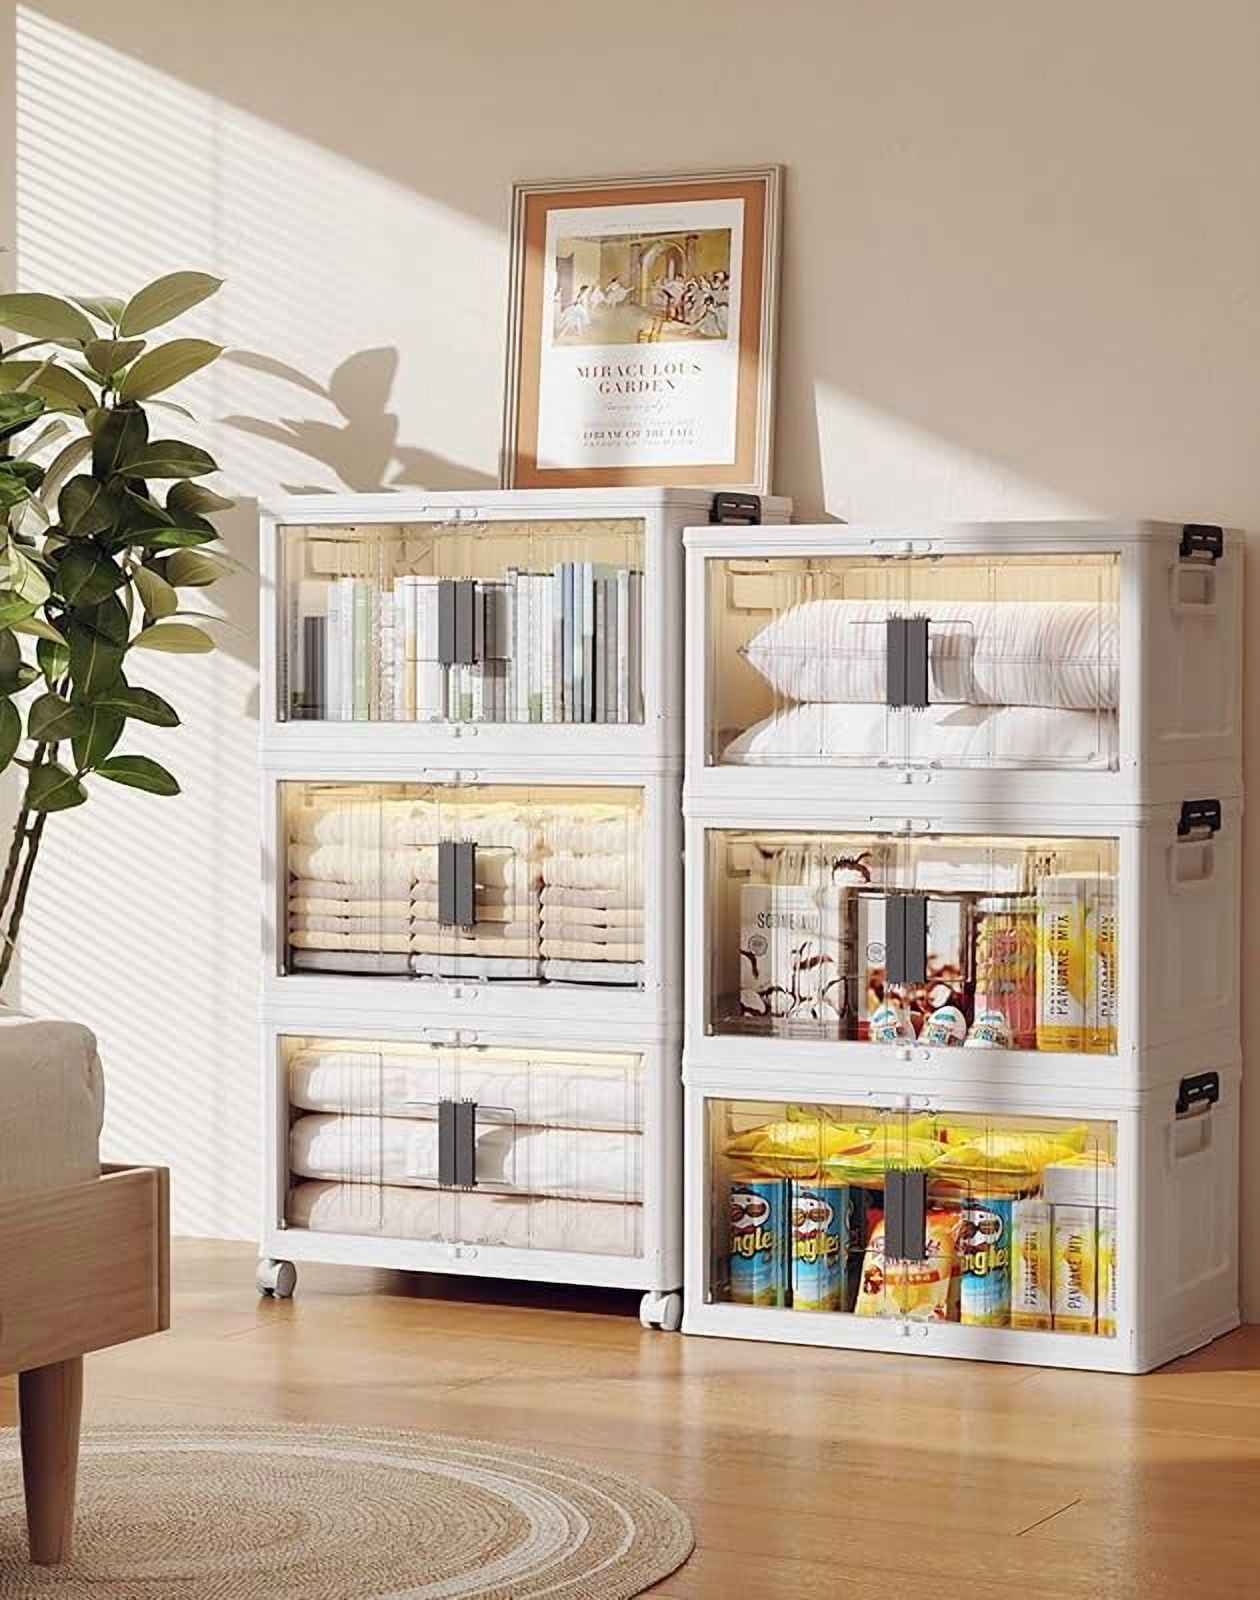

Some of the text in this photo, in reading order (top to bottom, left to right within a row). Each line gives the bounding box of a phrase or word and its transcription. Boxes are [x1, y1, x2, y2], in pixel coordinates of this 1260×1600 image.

[577, 363, 702, 379] MIRACULOUS
[598, 379, 676, 394] GARDEN
[1056, 915, 1070, 941] MIX
